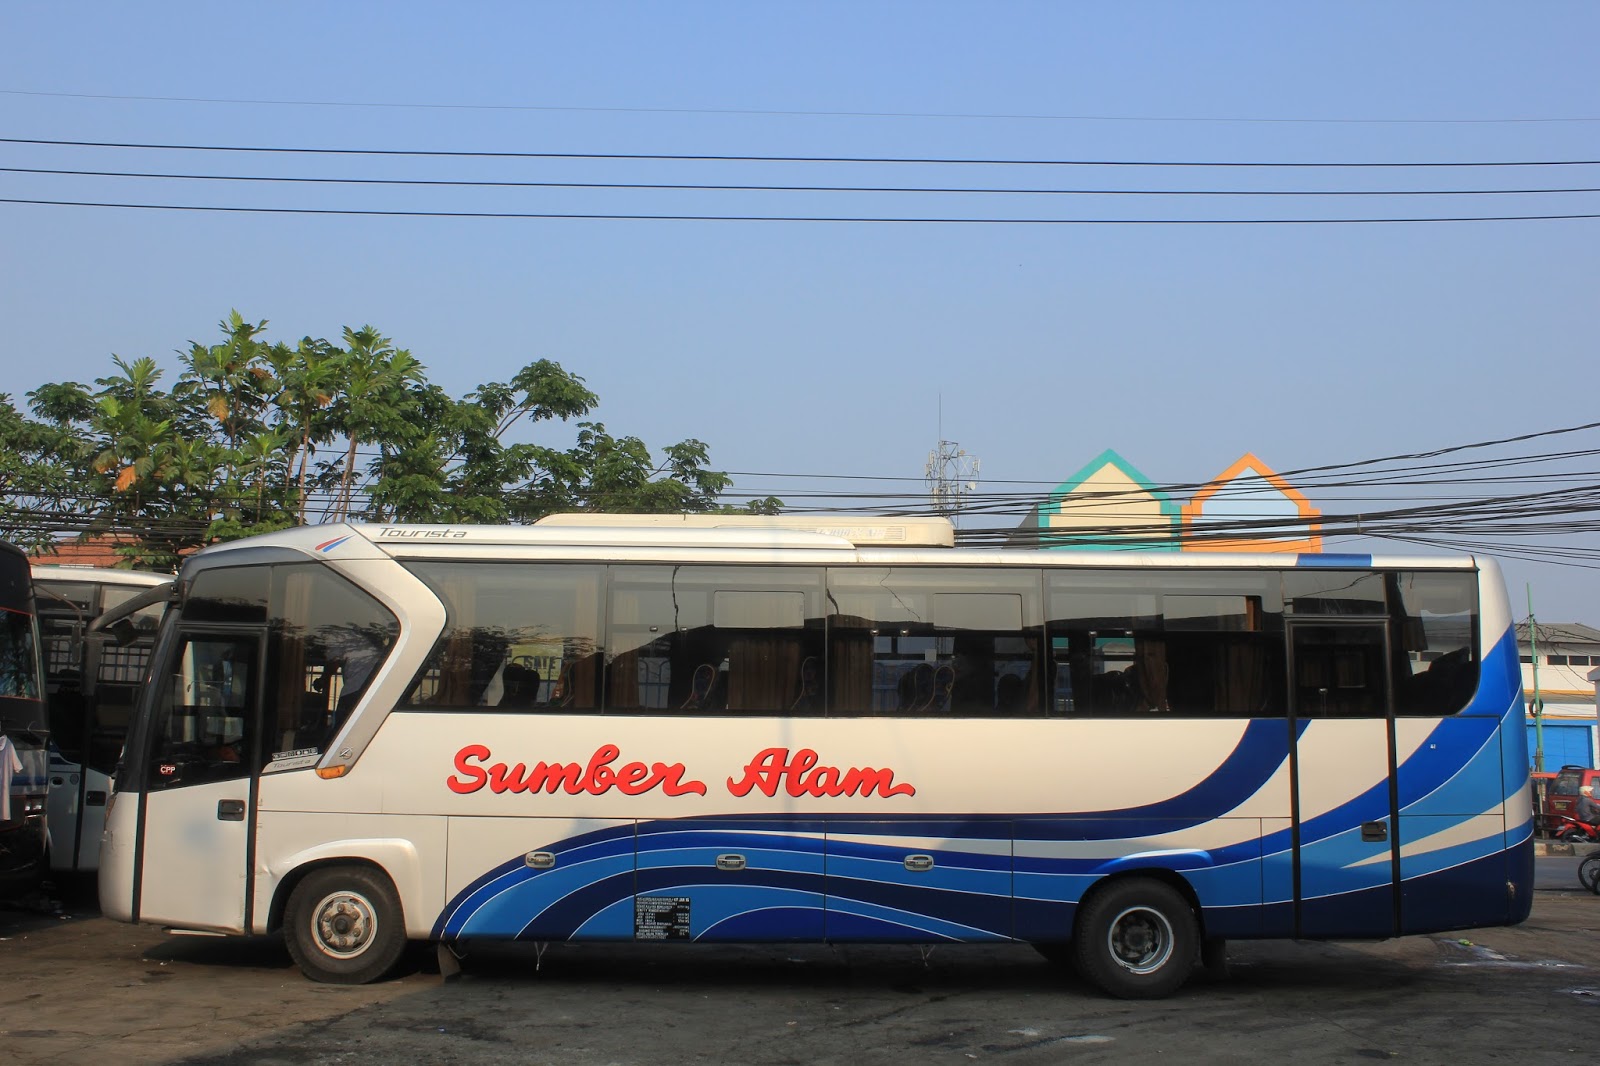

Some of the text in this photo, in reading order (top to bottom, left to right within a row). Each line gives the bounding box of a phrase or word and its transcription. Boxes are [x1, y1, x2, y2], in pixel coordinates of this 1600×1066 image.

[379, 527, 468, 538] Tourista
[446, 744, 917, 798] Sumber Alam
